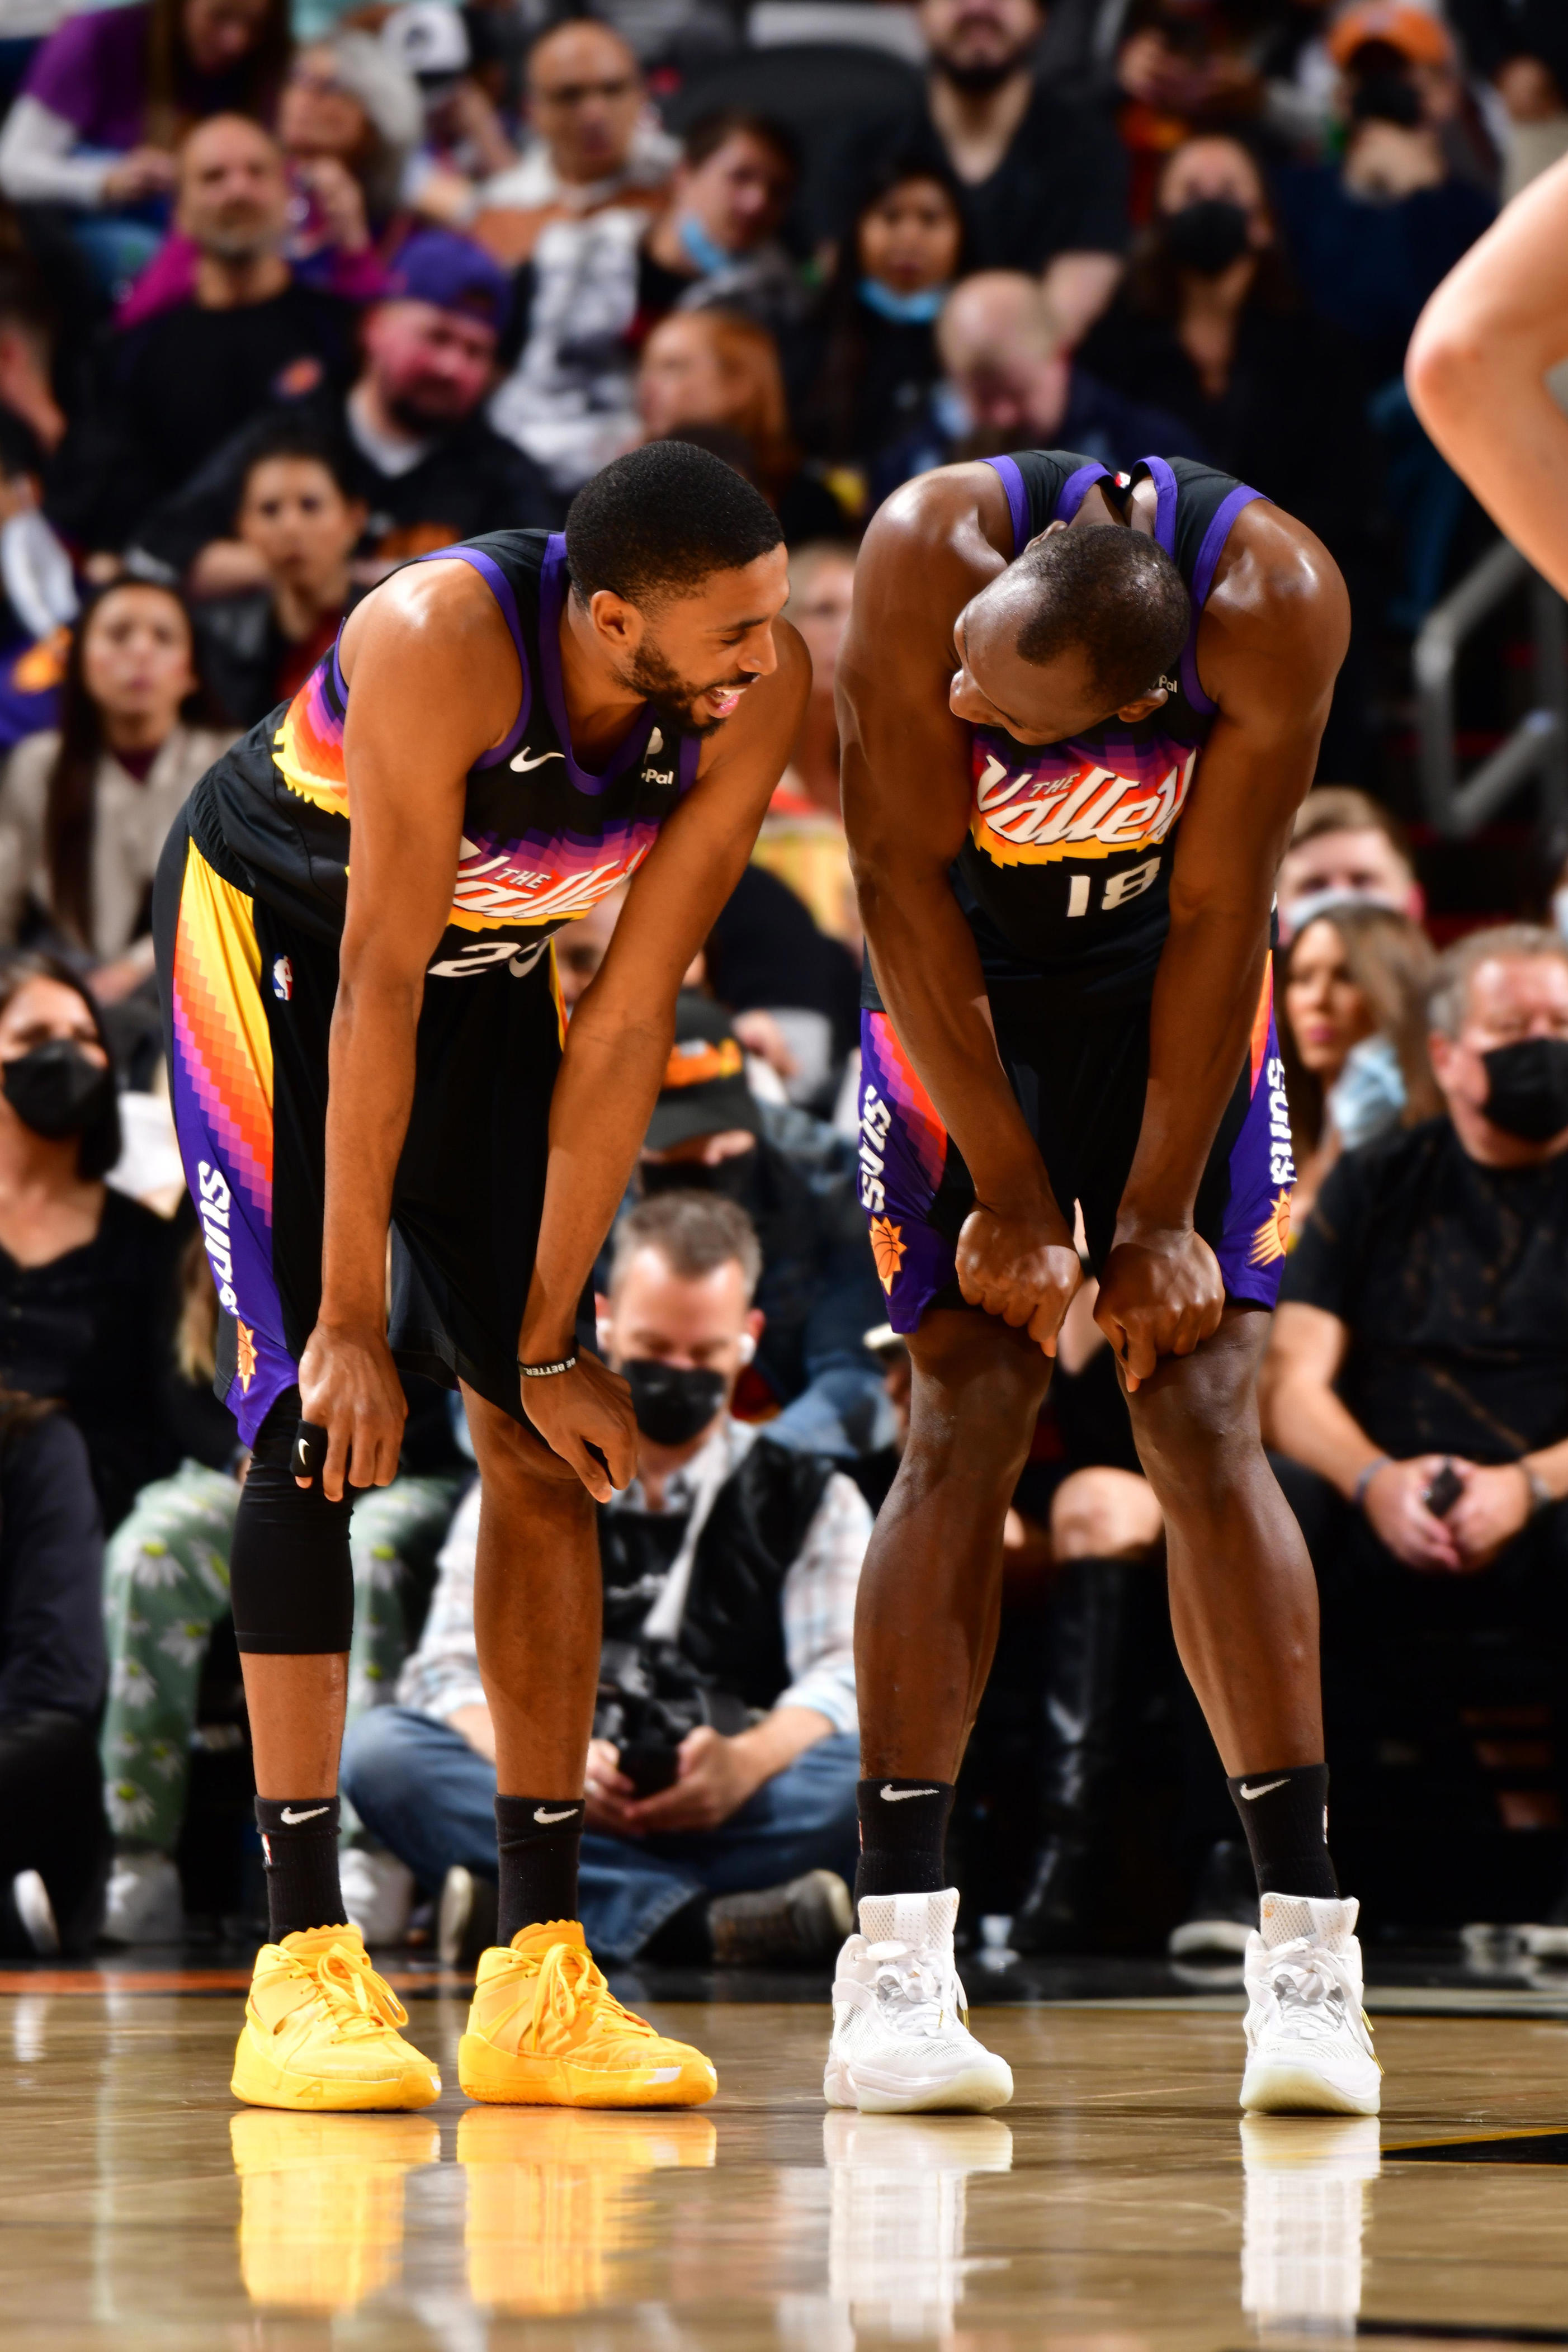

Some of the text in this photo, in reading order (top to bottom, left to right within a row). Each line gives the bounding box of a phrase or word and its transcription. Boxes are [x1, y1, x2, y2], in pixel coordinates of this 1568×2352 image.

[641, 768, 674, 785] Pal
[1028, 773, 1081, 799] THE
[977, 747, 1197, 846] Valley
[494, 867, 552, 890] THE
[1066, 857, 1161, 918] 18
[566, 1357, 576, 1369] BE
